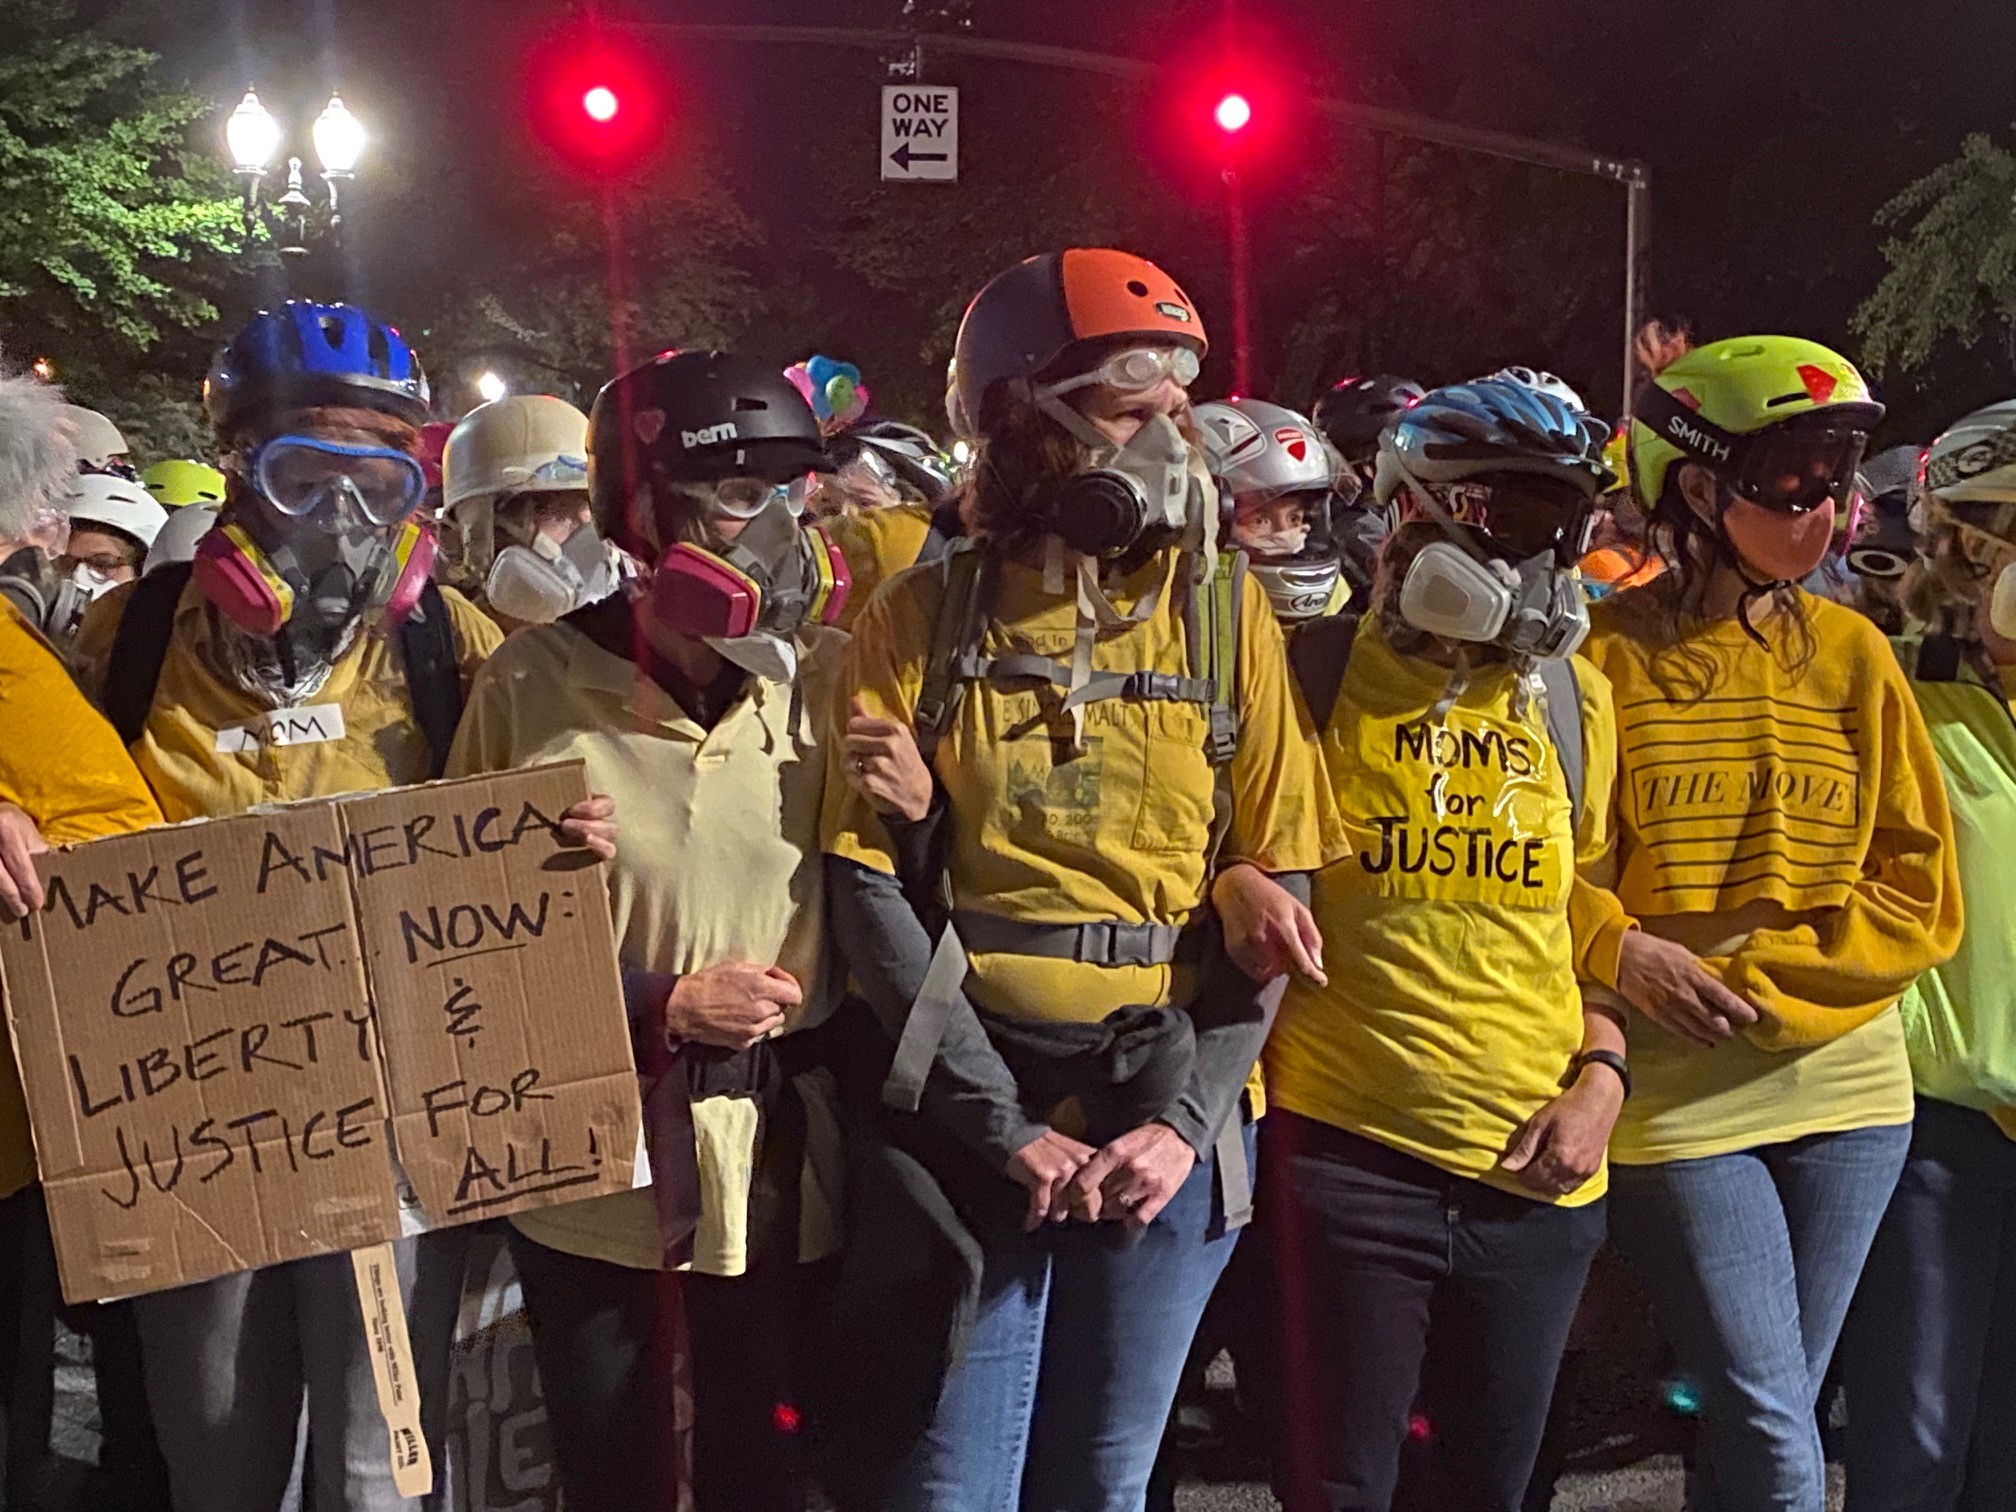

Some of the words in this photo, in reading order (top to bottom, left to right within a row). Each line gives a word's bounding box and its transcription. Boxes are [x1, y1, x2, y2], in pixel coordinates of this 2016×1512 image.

[892, 118, 949, 138] WAY
[893, 93, 948, 113] ONE
[1668, 415, 1730, 462] SMITH
[241, 716, 327, 751] MOM
[1394, 722, 1532, 776] MOMS
[1424, 771, 1487, 817] for
[1642, 770, 1729, 812] THE
[1734, 767, 1850, 813] MOVE
[20, 850, 218, 942] MAKE
[257, 801, 566, 894] AMERICA
[1359, 815, 1545, 888] JUSTICE
[69, 1010, 373, 1118] LIBERTY
[101, 1097, 375, 1210] JUSTICE
[421, 1067, 555, 1138] FOR
[453, 1126, 603, 1202] ALL!
